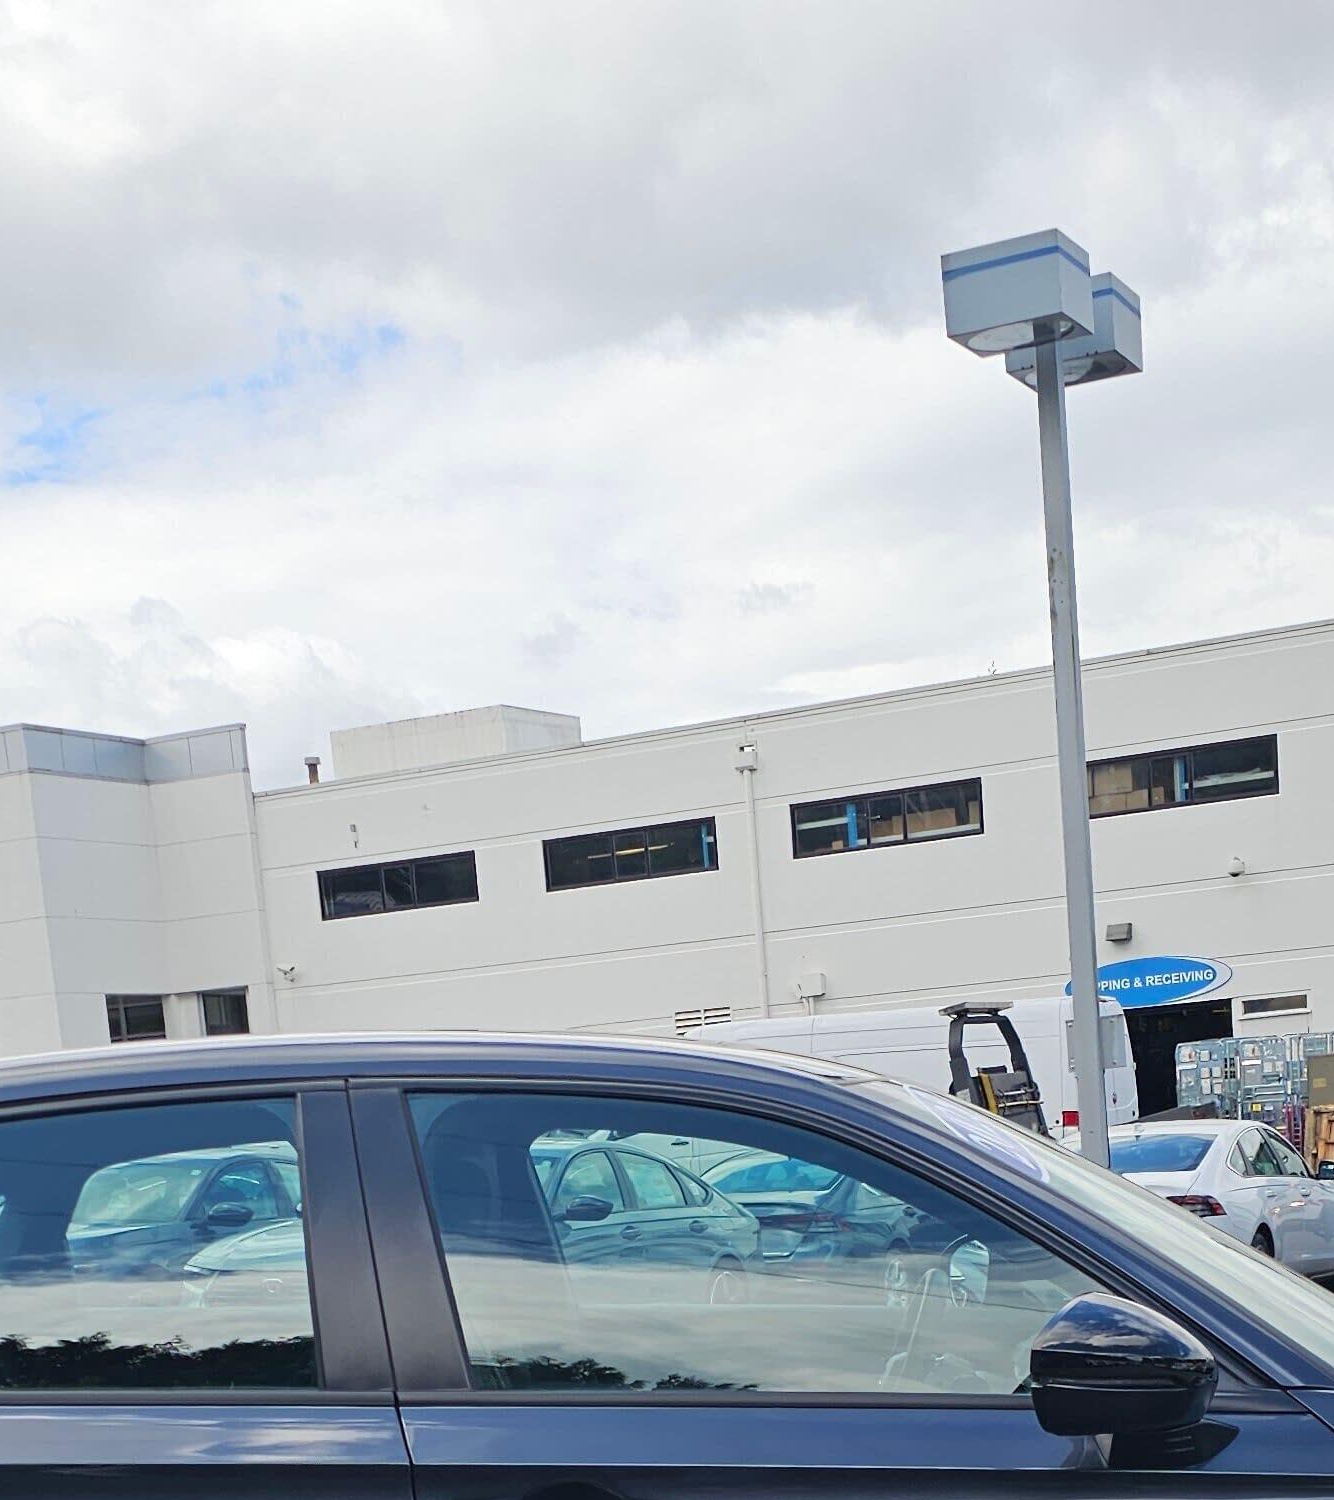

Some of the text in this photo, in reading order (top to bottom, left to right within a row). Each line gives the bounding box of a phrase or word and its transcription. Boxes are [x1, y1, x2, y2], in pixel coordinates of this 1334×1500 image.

[1098, 969, 1214, 991] PING & RECEIVING
